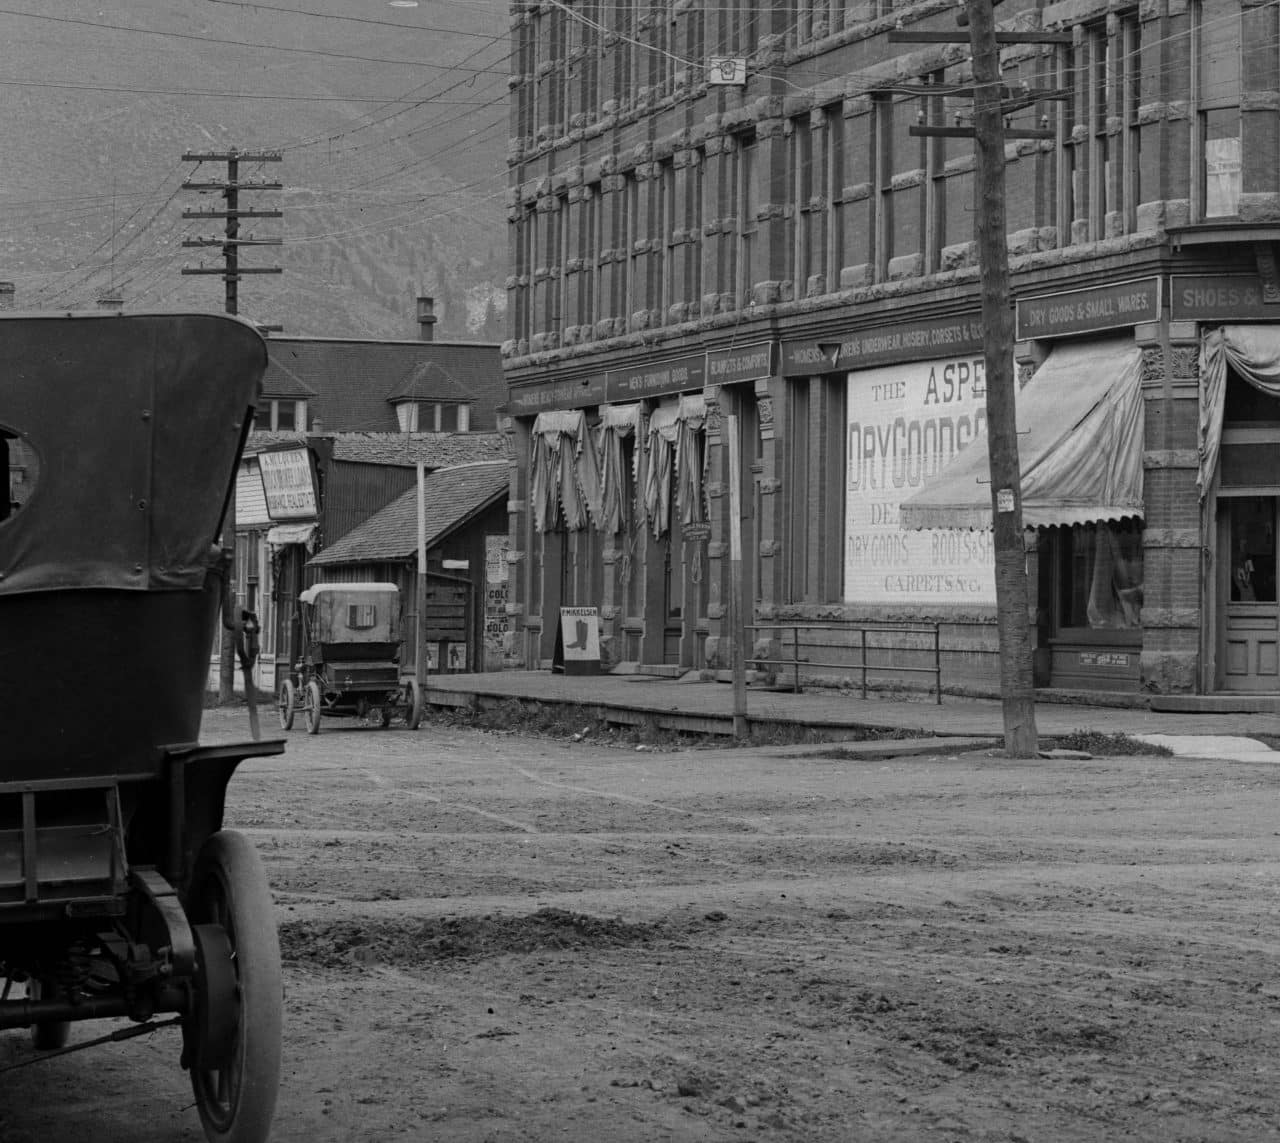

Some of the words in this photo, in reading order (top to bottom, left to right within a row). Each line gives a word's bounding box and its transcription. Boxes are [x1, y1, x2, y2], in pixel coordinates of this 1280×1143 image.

[1029, 309, 1046, 327] DRY
[1049, 306, 1075, 325] GOODS
[1085, 297, 1114, 319] SMALL
[1183, 287, 1240, 307] SHOES
[1243, 287, 1259, 306] &
[931, 325, 961, 347] CORSETS
[872, 381, 906, 402] THE
[923, 359, 986, 405] ASPE
[848, 421, 892, 492] DRY
[848, 535, 870, 567] DRY
[871, 534, 909, 567] GOODS
[884, 575, 955, 593] CARPETS
